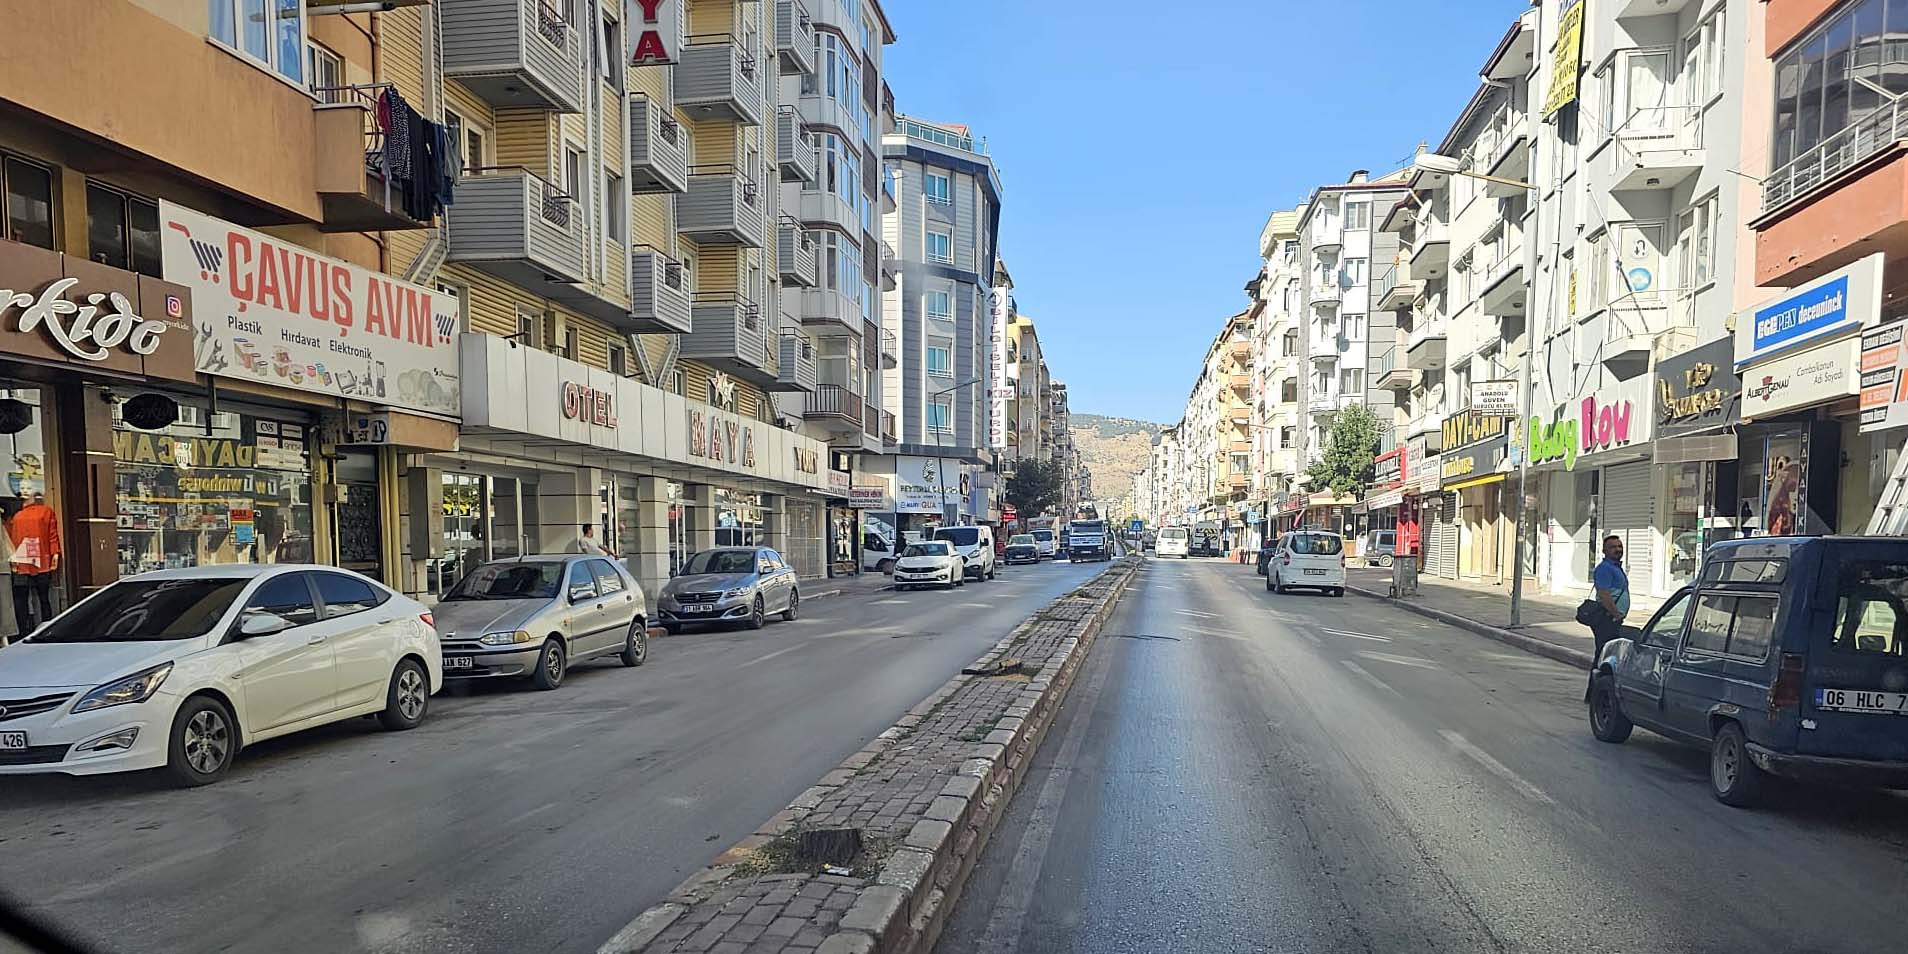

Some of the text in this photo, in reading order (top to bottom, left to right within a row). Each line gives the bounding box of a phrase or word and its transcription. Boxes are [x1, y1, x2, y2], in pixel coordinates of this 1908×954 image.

[227, 231, 434, 348] ÇAVUŞ AVM
[1798, 290, 1843, 324] deceuninck
[227, 315, 373, 360] Plastik Hırdavat Elektronik
[562, 380, 618, 429] OTEL
[688, 410, 757, 468] MAYA
[1826, 690, 1846, 706] 06
[1856, 691, 1884, 709] HLC
[3, 733, 24, 748] 426
